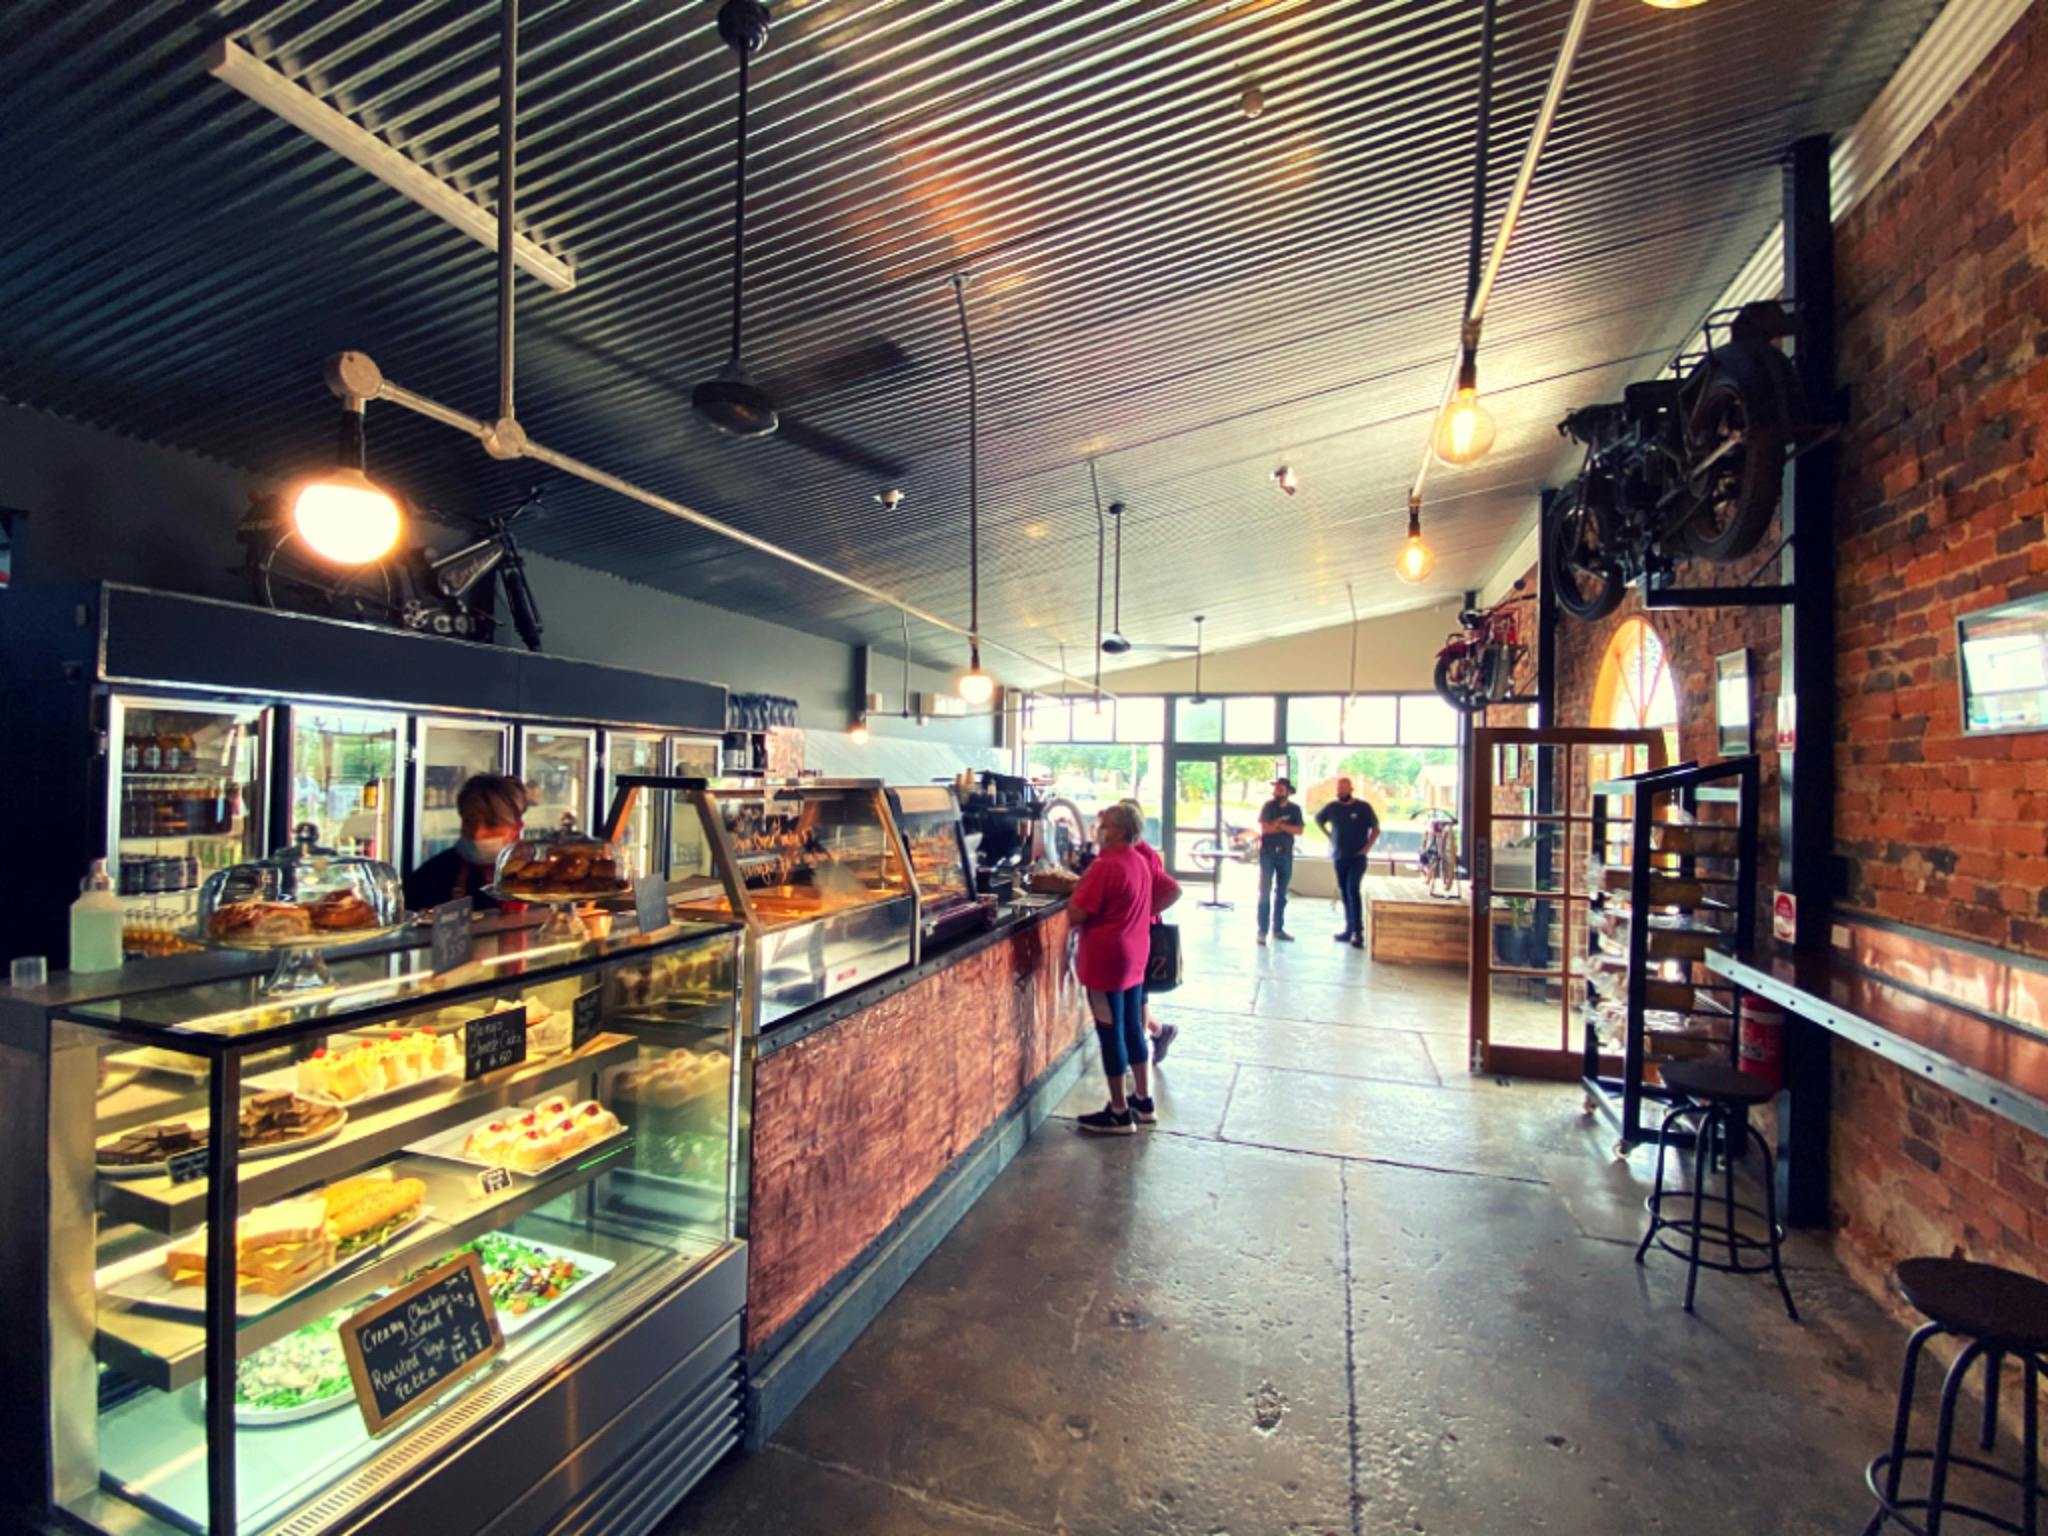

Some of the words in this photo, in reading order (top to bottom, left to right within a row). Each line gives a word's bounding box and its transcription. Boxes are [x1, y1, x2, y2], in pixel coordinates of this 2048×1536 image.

[362, 1320, 409, 1353] Creamy
[408, 1294, 449, 1321] Chicken
[371, 1350, 420, 1391] Roasted
